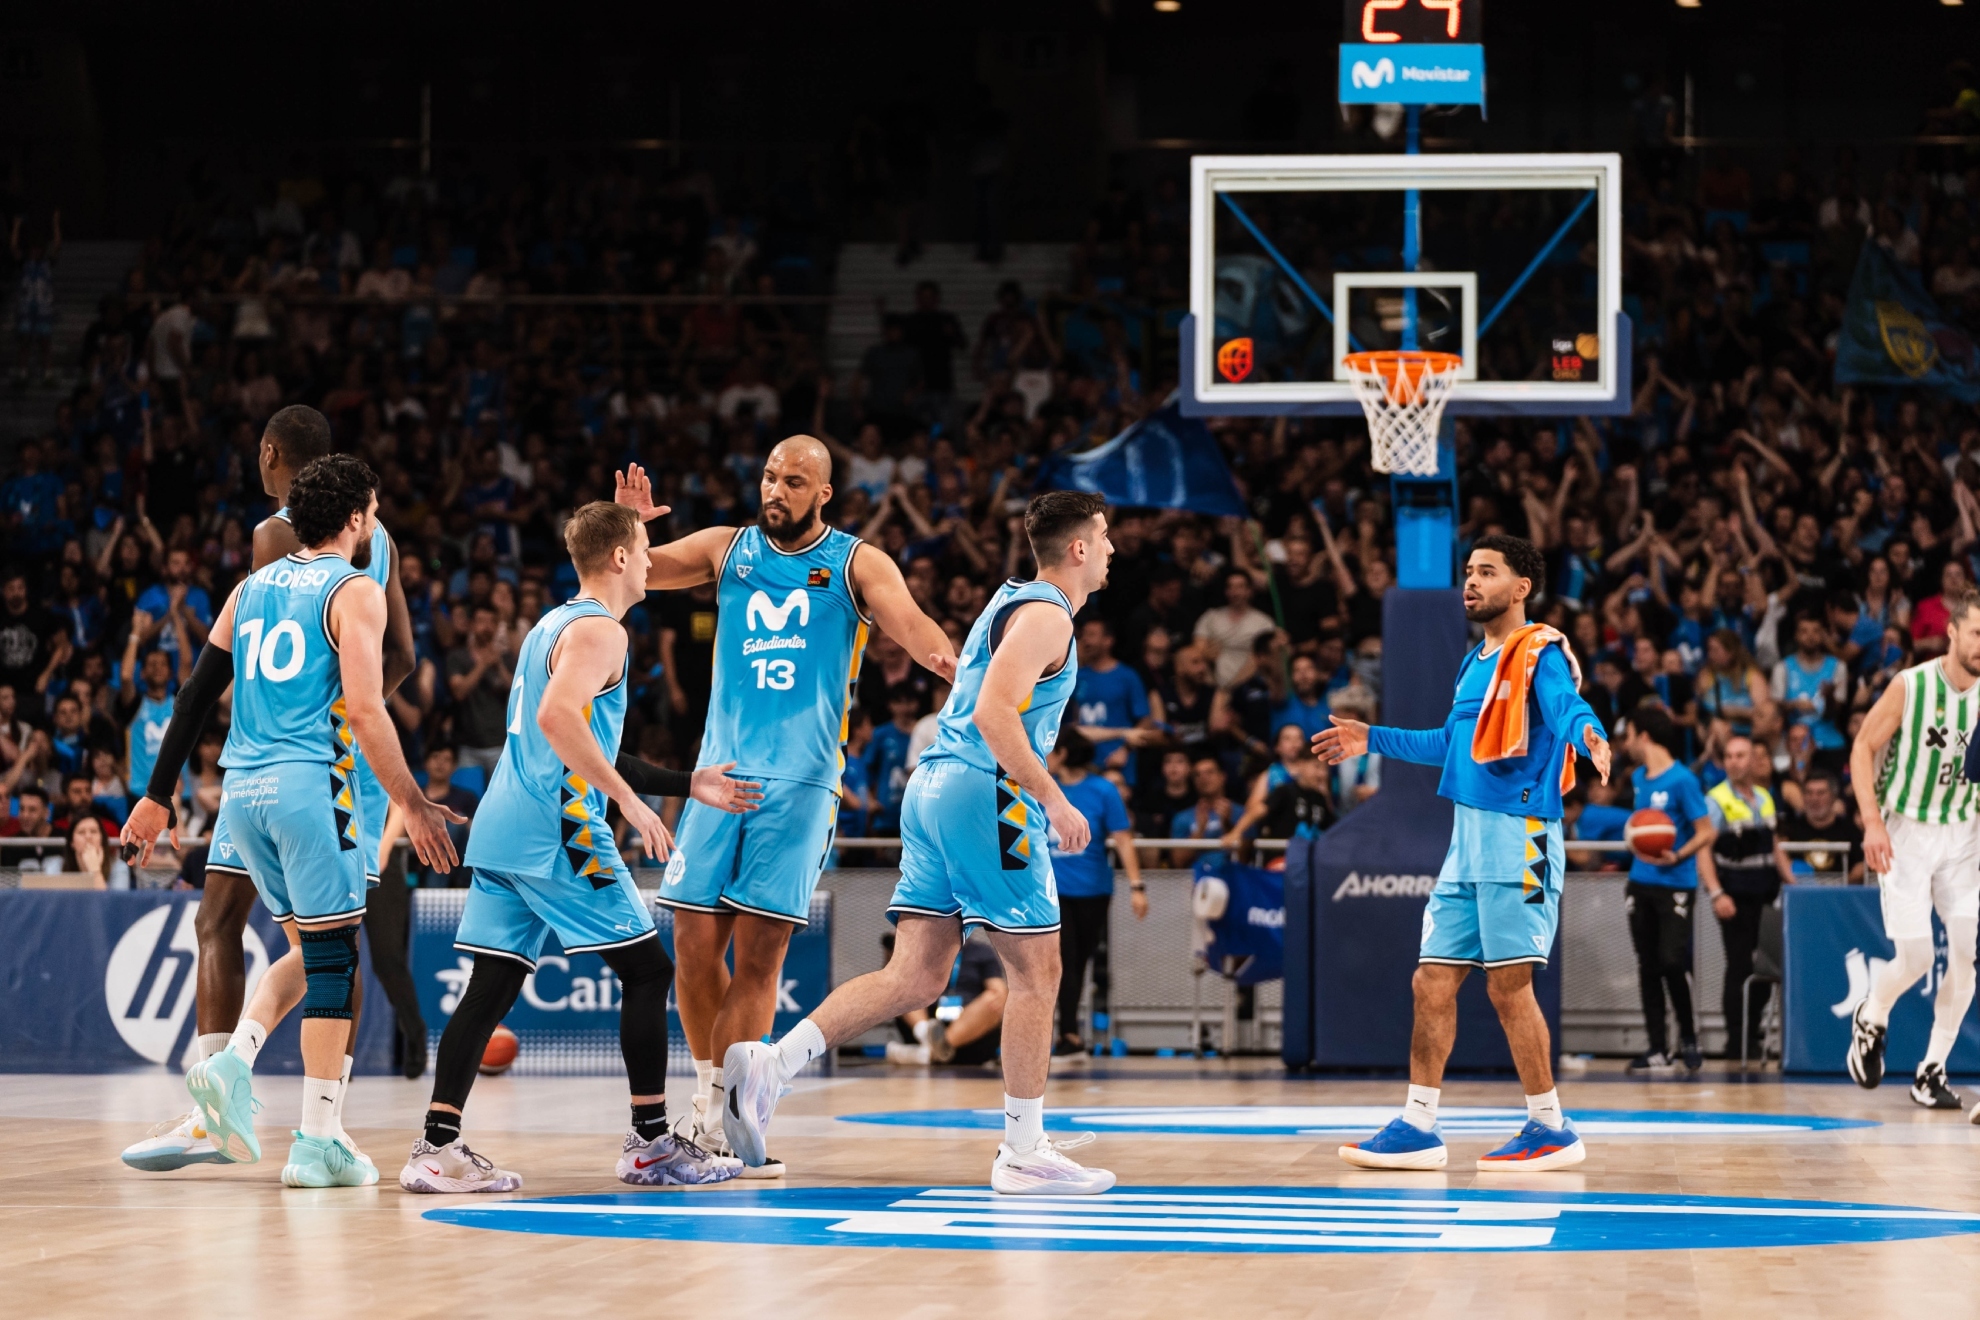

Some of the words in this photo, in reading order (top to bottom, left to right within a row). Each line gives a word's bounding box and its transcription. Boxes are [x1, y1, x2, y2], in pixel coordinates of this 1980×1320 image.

[1402, 66, 1471, 82] Movistar
[1552, 356, 1582, 370] LEB
[252, 568, 330, 589] ALONSO
[239, 618, 306, 682] 10
[743, 633, 806, 656] Estudiantes
[751, 658, 796, 690] 13
[246, 777, 278, 786] Fundación
[230, 788, 259, 800] Jiménez
[259, 785, 278, 795] Díaz
[1331, 870, 1438, 901] AHORR
